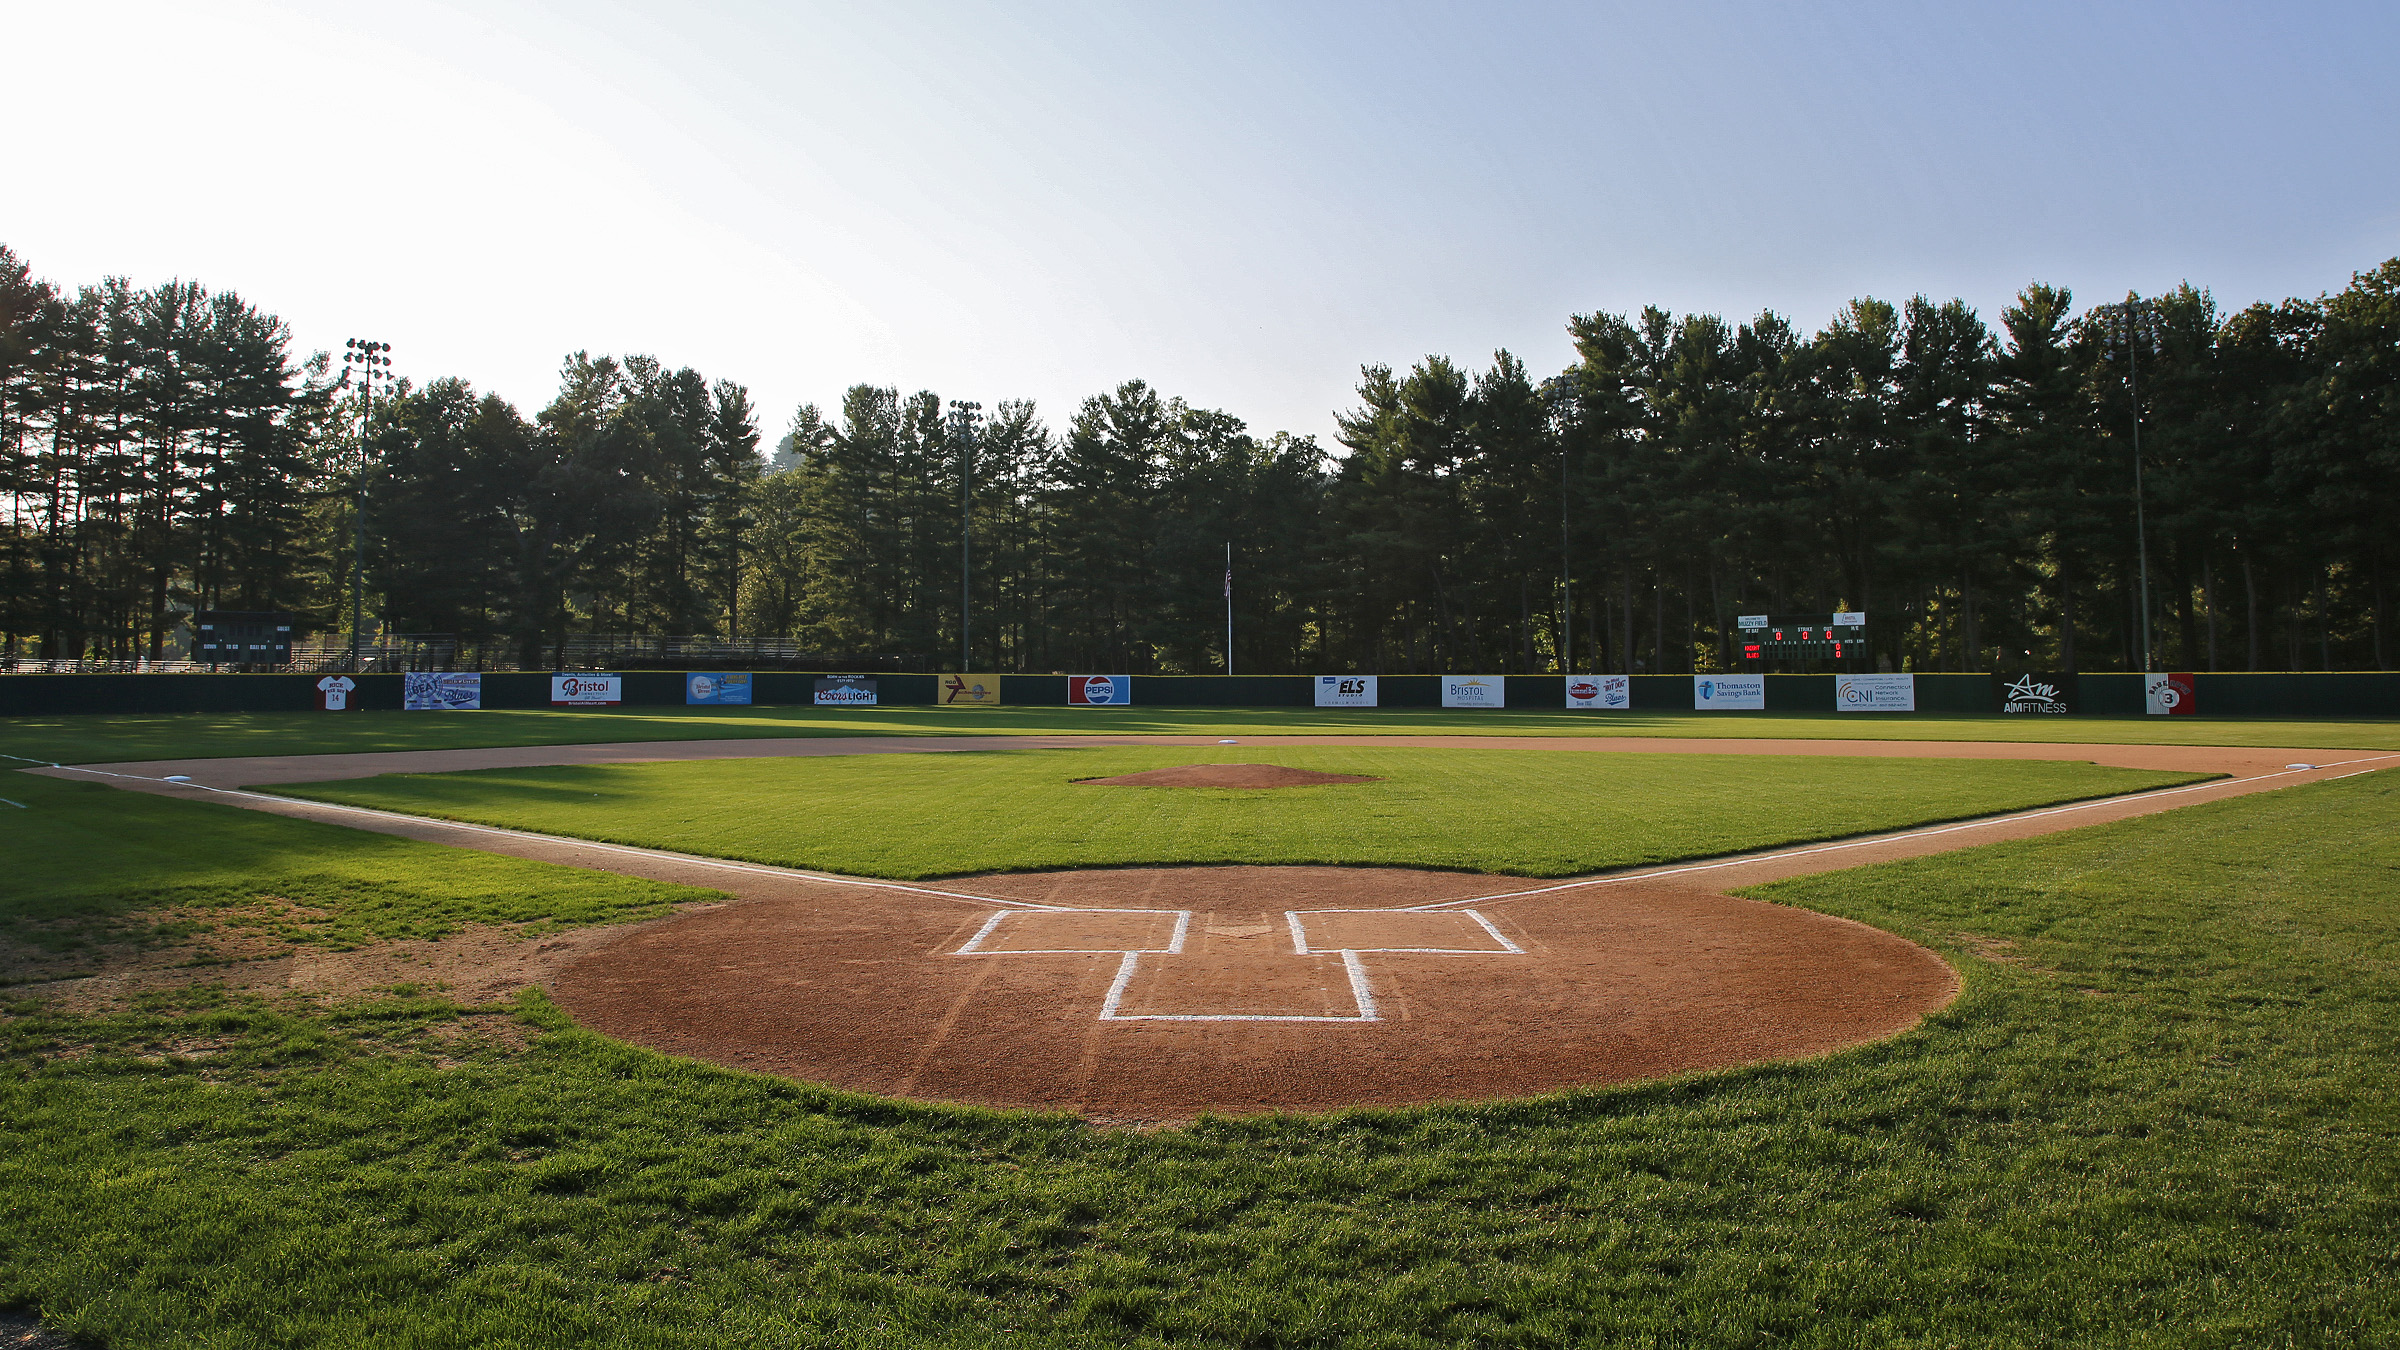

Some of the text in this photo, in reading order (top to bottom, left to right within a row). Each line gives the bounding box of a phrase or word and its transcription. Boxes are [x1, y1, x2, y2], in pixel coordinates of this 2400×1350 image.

[1776, 631, 1782, 641] 0
[1802, 630, 1809, 640] 0
[1826, 630, 1832, 640] 0
[1835, 650, 1842, 658] 0
[411, 679, 438, 695] BEAT
[562, 678, 609, 697] Bristol
[1085, 686, 1113, 694] PEPSI
[1339, 680, 1366, 694] ELS
[1716, 682, 1761, 690] Thomaston
[2148, 680, 2168, 695] BABE
[817, 690, 875, 701] Coors LIGHT
[1716, 690, 1742, 698] Savings
[1846, 690, 1873, 703] CNI
[2164, 693, 2174, 704] 3
